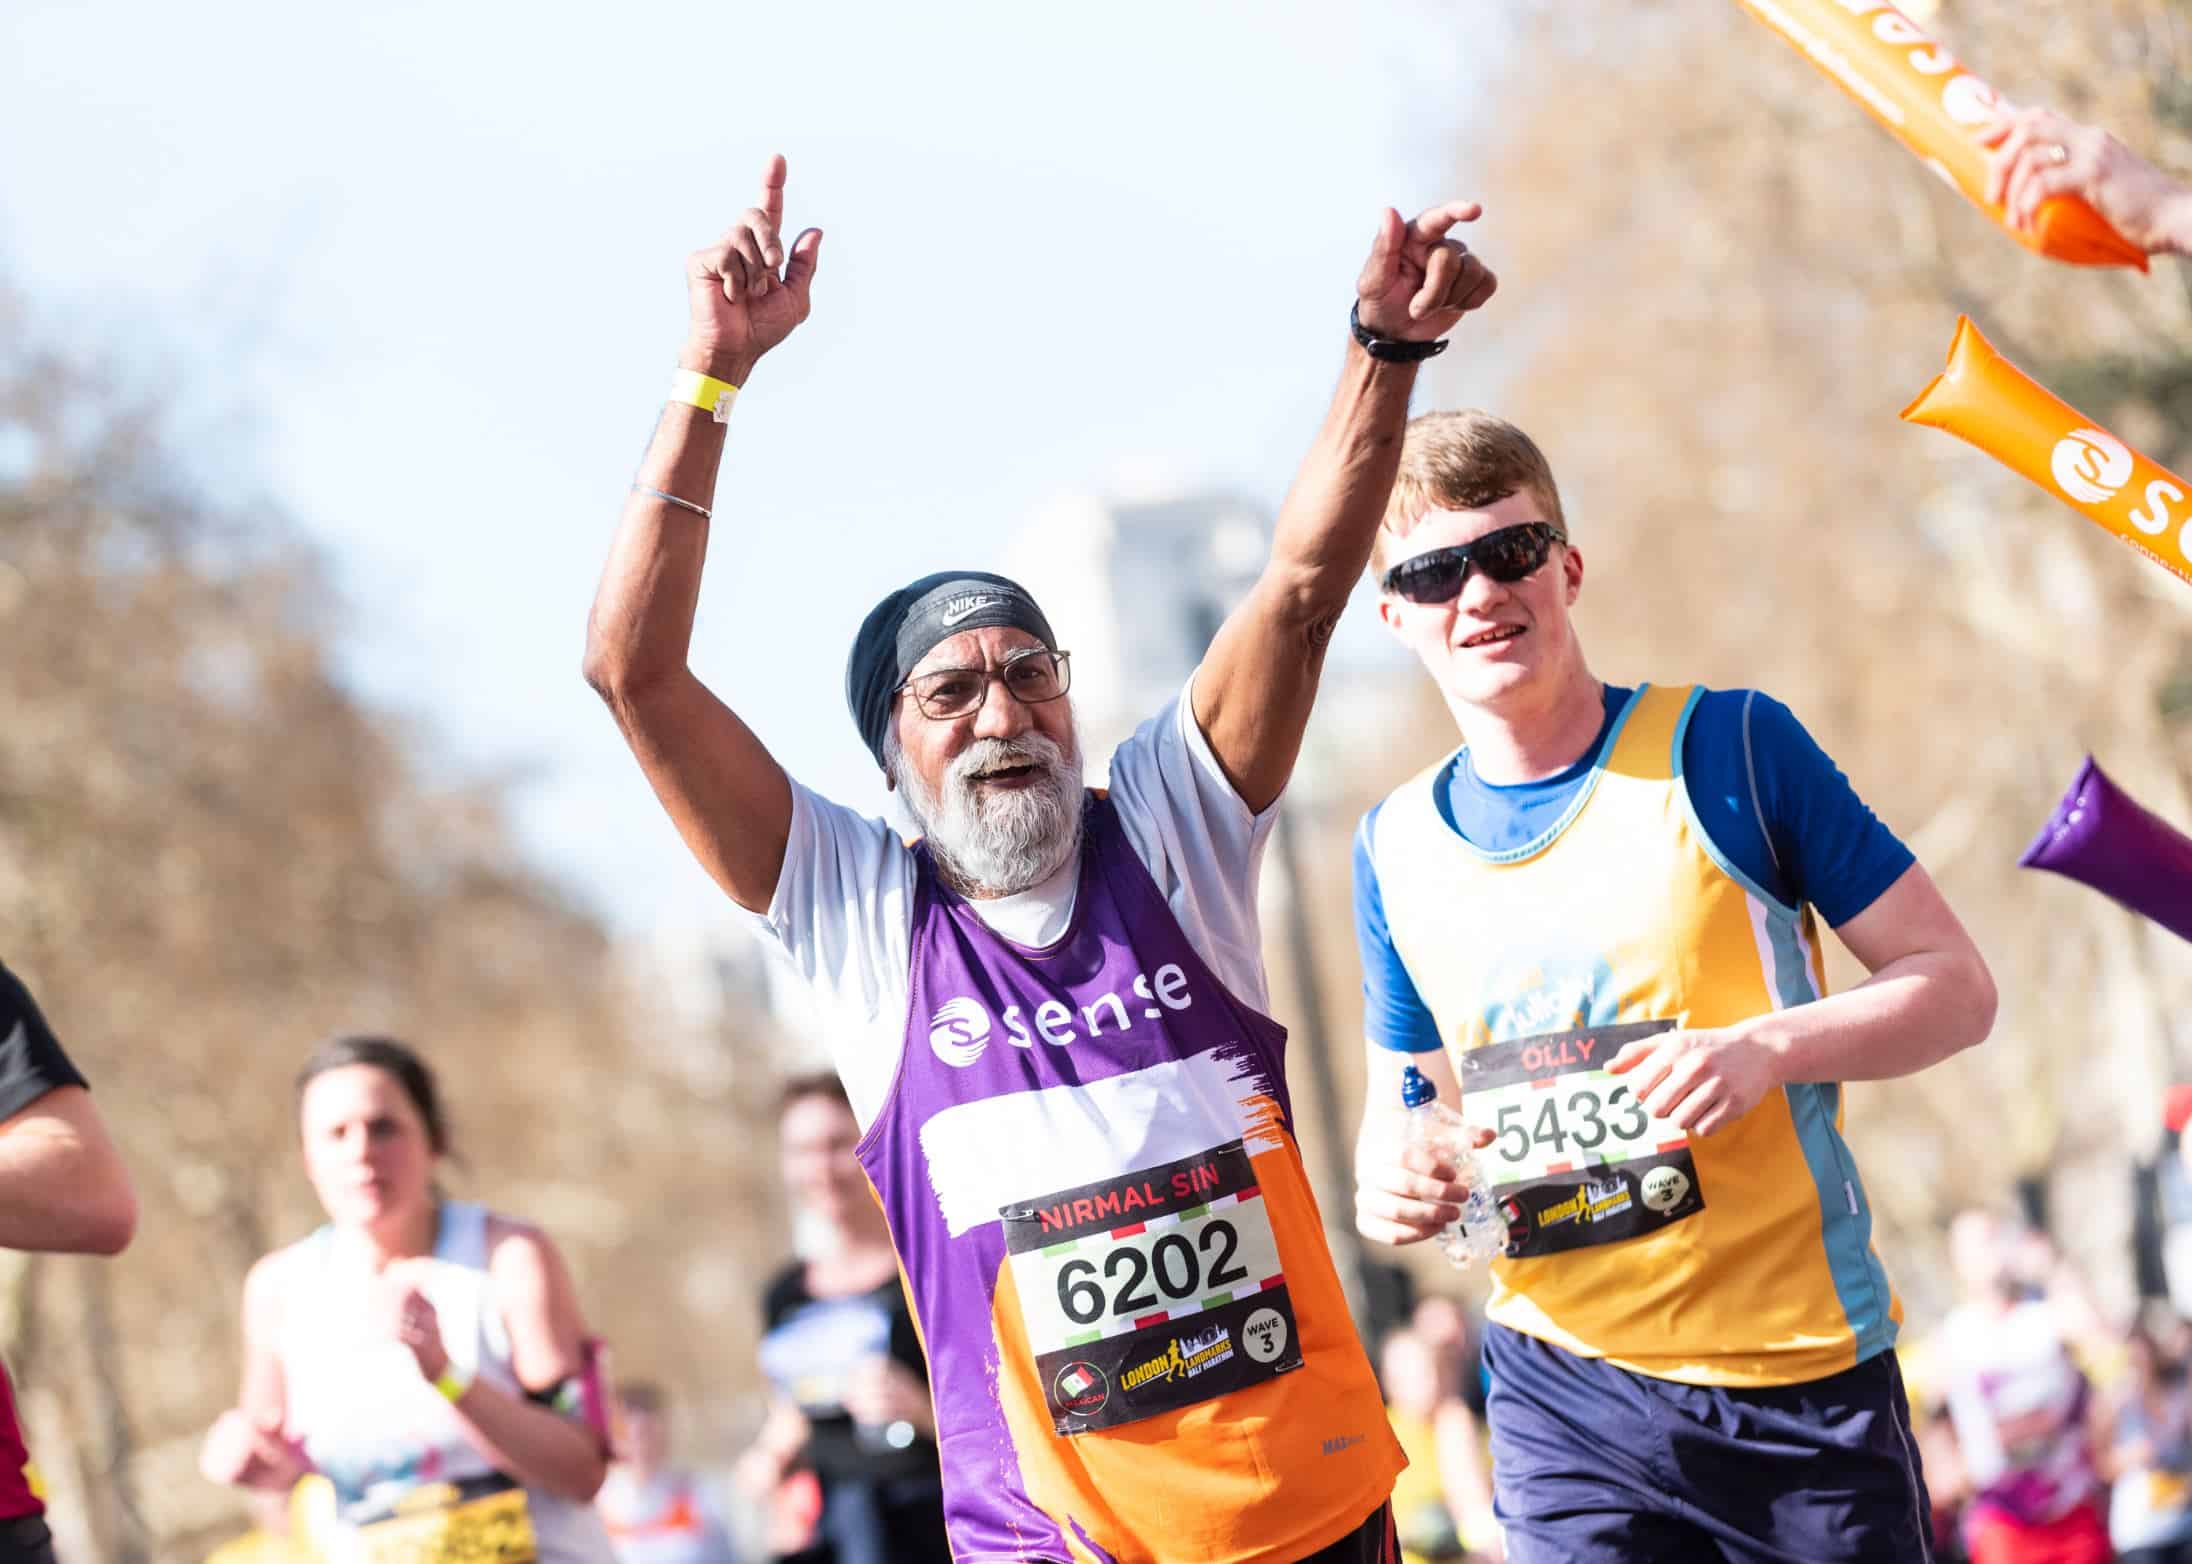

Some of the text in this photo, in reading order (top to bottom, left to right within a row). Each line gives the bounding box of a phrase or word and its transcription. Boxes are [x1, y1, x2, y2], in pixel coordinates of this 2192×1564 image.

[2128, 479, 2192, 565] s
[949, 596, 987, 614] NIKE
[1002, 963, 1192, 1048] sense
[1521, 1038, 1595, 1071] OLLY
[1497, 1085, 1649, 1162] 5433
[1040, 1163, 1219, 1232] NIRMAL SIN
[1660, 1189, 1674, 1202] 3
[1057, 1219, 1248, 1325] 6202
[1246, 1318, 1279, 1337] WAVE
[1260, 1333, 1275, 1354] 3
[1185, 1339, 1232, 1369] LANDMARKS
[1120, 1354, 1169, 1391] LONDON
